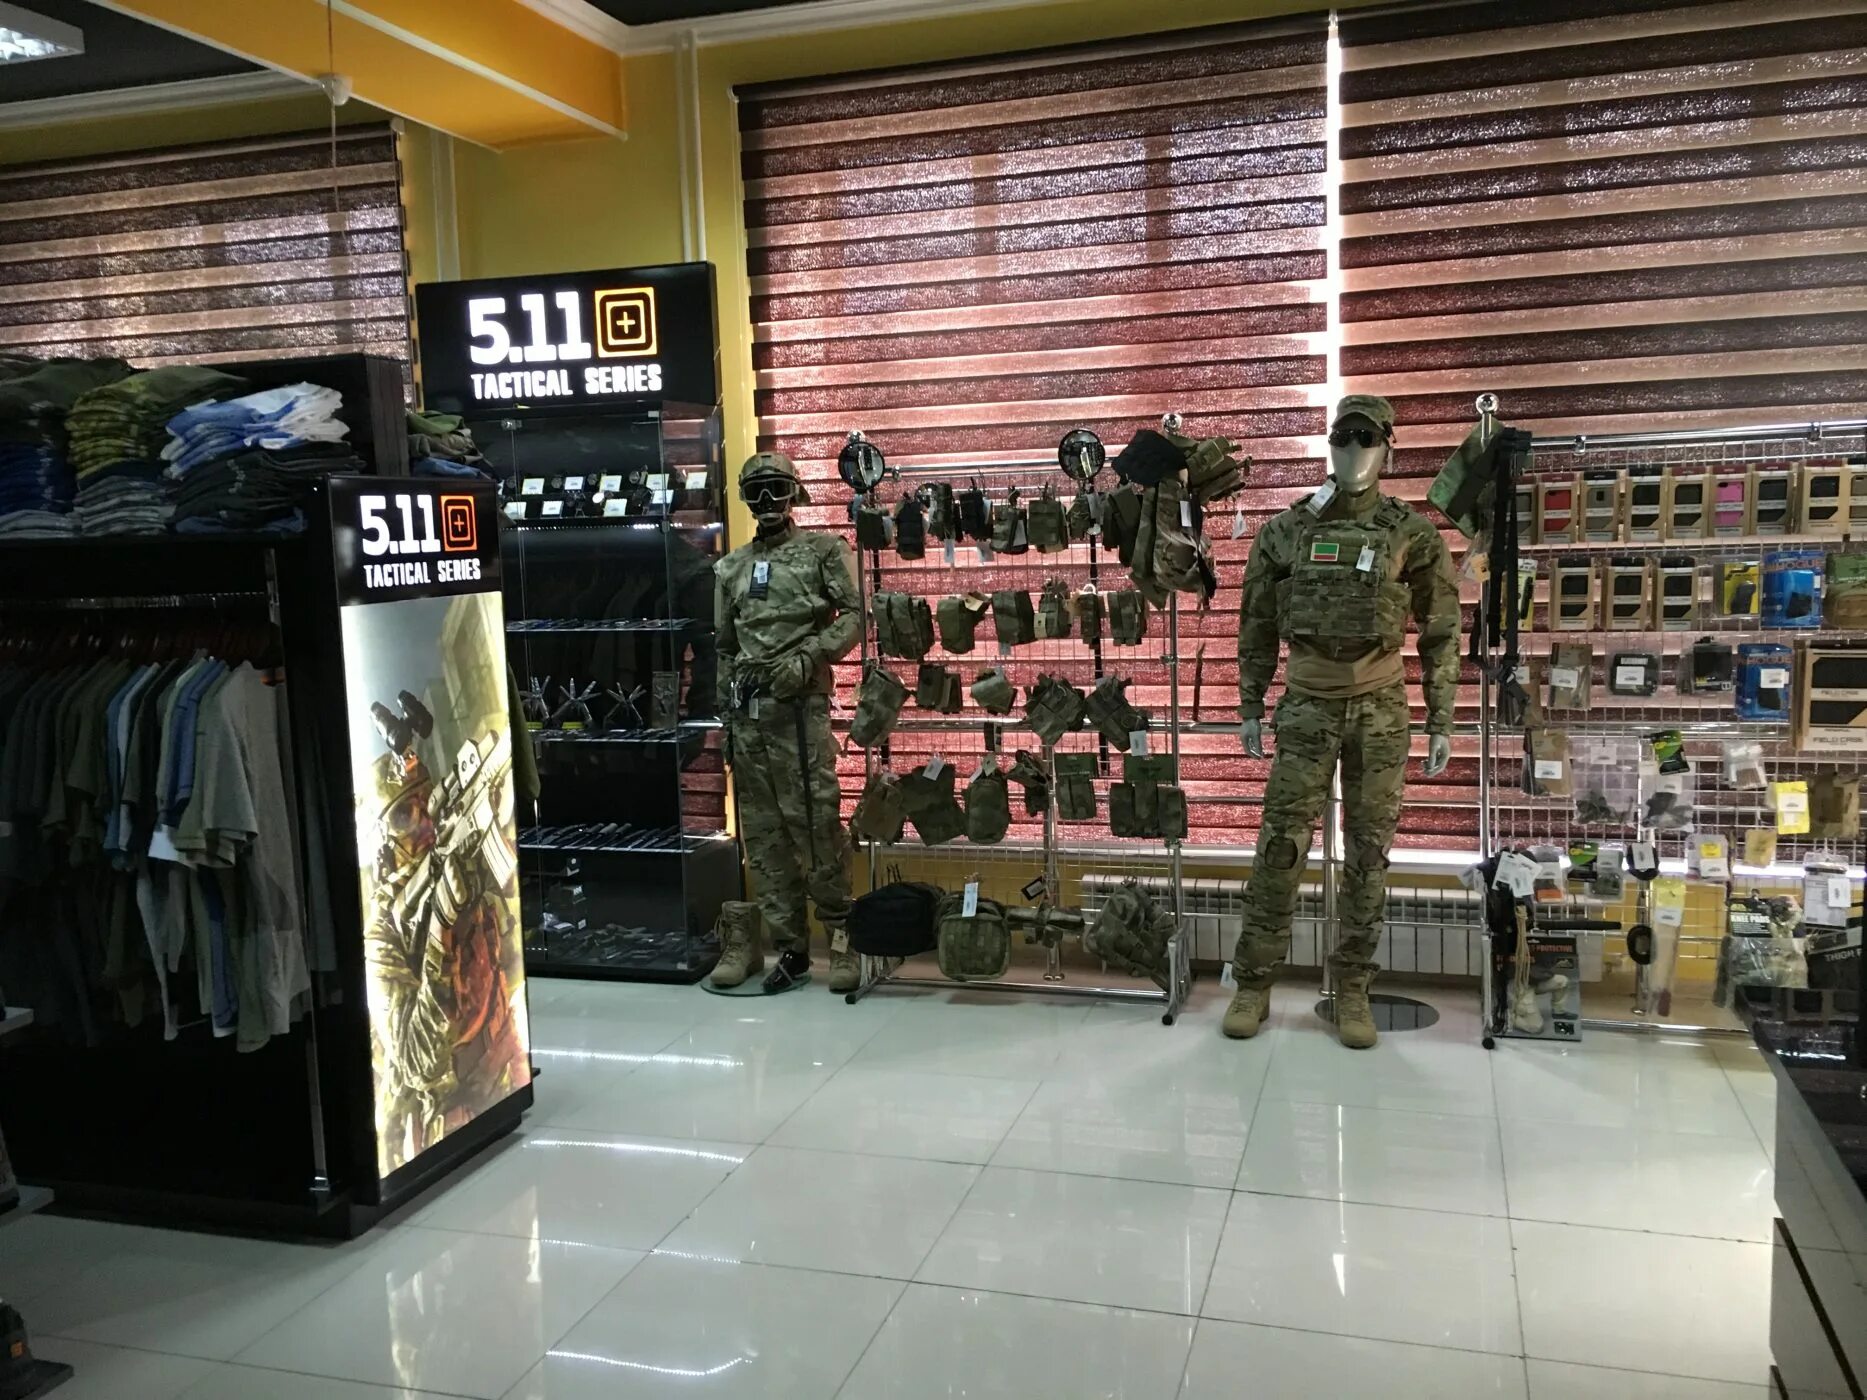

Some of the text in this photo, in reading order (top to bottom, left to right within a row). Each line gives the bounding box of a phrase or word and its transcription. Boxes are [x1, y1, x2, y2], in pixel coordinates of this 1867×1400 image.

[468, 291, 592, 365] 5.11
[470, 363, 662, 400] TACTICAL SERIES
[359, 494, 442, 556] 5.11
[363, 557, 481, 589] TACTICAL SERIES
[1824, 950, 1855, 962] THIGH
